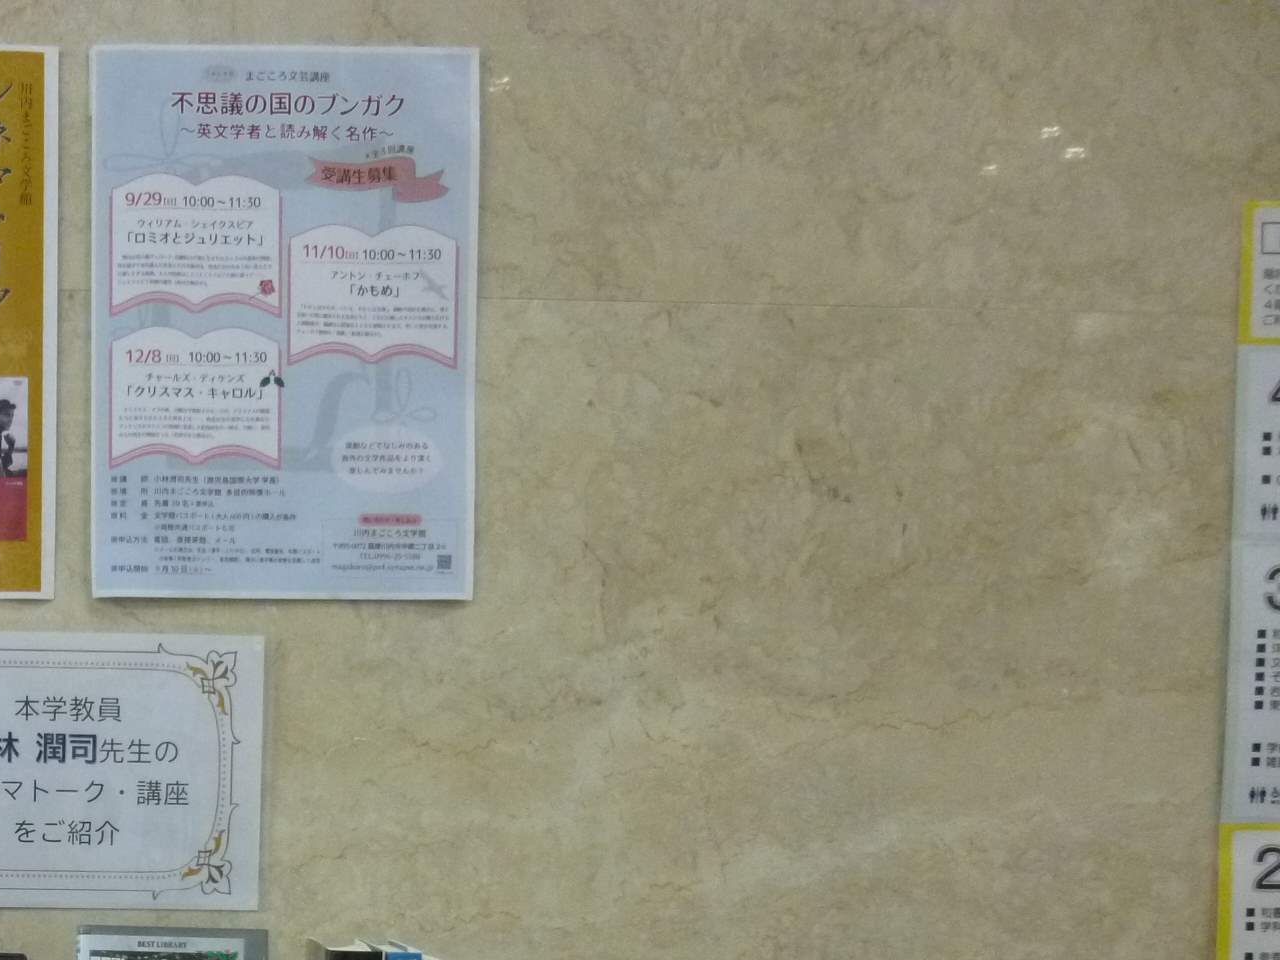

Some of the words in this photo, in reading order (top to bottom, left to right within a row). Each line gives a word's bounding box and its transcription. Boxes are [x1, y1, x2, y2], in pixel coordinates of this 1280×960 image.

[172, 91, 406, 117] 不思議の国のブンガク
[322, 165, 399, 184] 受講生募集
[127, 231, 264, 246] 「ロミオとジュリエット」
[350, 284, 400, 298] 「かもめ」
[127, 386, 264, 400] 「クリスマス・キャロル」
[15, 696, 122, 722] 本学教員
[36, 732, 179, 764] 潤司先生の
[15, 820, 120, 846] をご紹介
[136, 940, 156, 949] BEST
